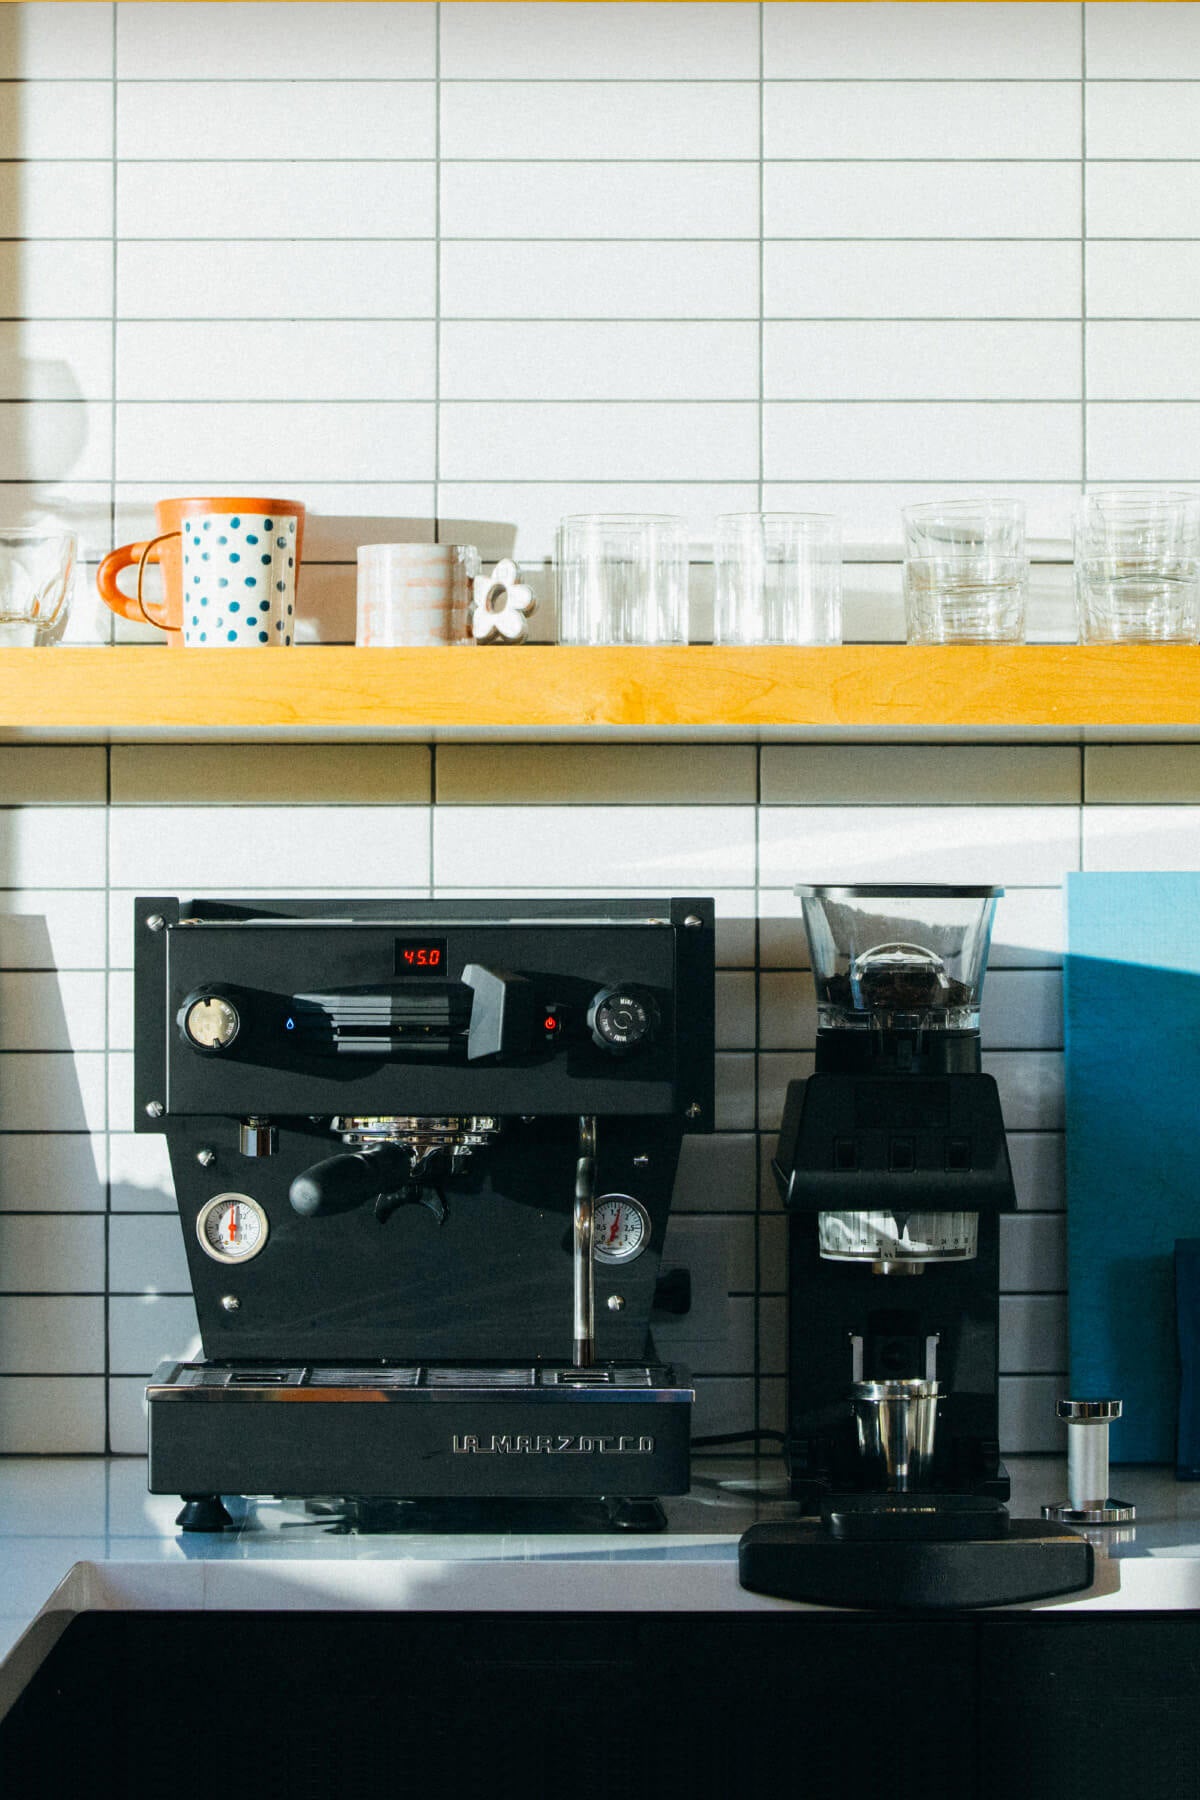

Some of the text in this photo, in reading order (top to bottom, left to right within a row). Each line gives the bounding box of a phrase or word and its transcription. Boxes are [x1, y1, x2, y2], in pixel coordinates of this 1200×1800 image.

[404, 949, 440, 966] 45.0
[453, 1434, 654, 1455] LA MARZOCCO
